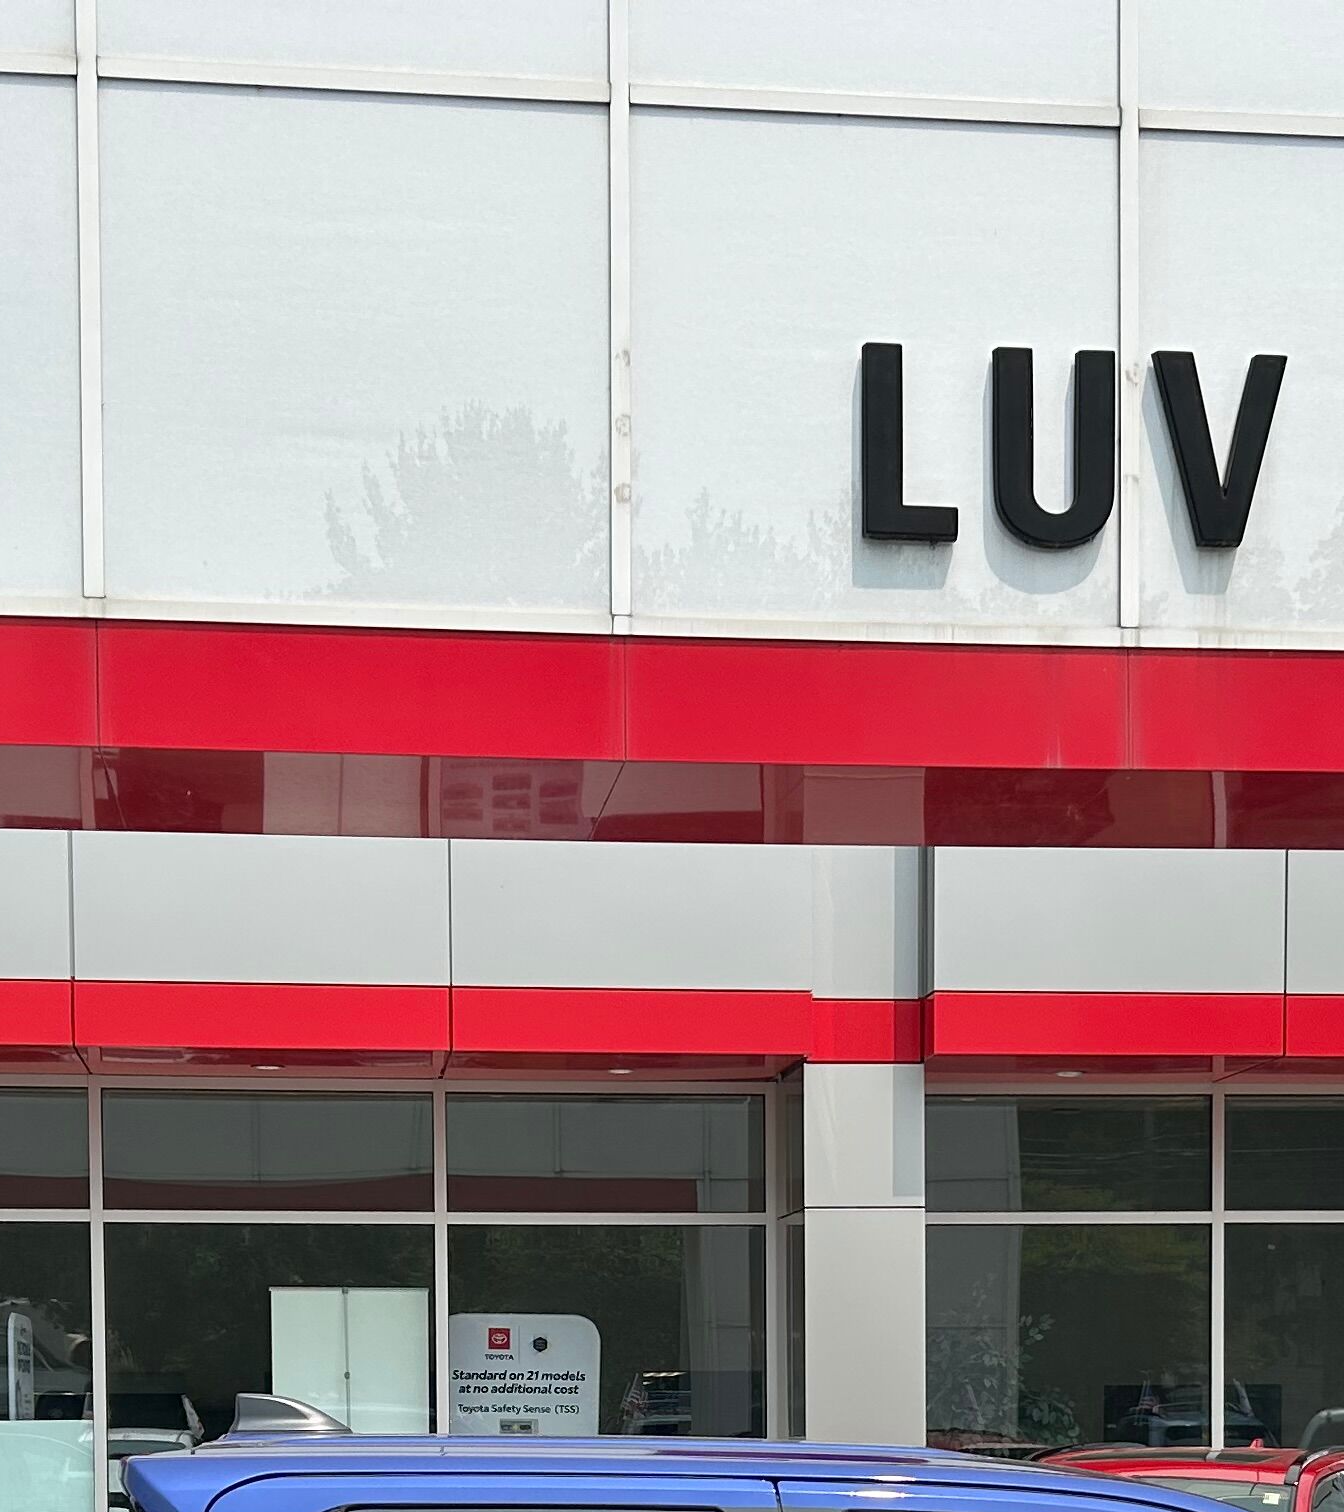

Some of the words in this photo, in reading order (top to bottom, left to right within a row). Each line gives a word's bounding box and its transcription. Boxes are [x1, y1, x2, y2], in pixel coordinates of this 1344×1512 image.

[861, 342, 1288, 548] LUV
[484, 1353, 515, 1361] TOYOTA
[451, 1369, 508, 1381] Standard
[509, 1372, 525, 1381] on
[526, 1370, 541, 1381] 21
[541, 1370, 587, 1382] models
[458, 1385, 472, 1395] at
[473, 1385, 490, 1395] no
[490, 1383, 553, 1395] additional
[553, 1385, 580, 1395] cost
[458, 1403, 490, 1415] Toyota
[490, 1403, 522, 1415] Safety
[522, 1404, 552, 1414] Sense
[554, 1403, 581, 1415] (TSS)
